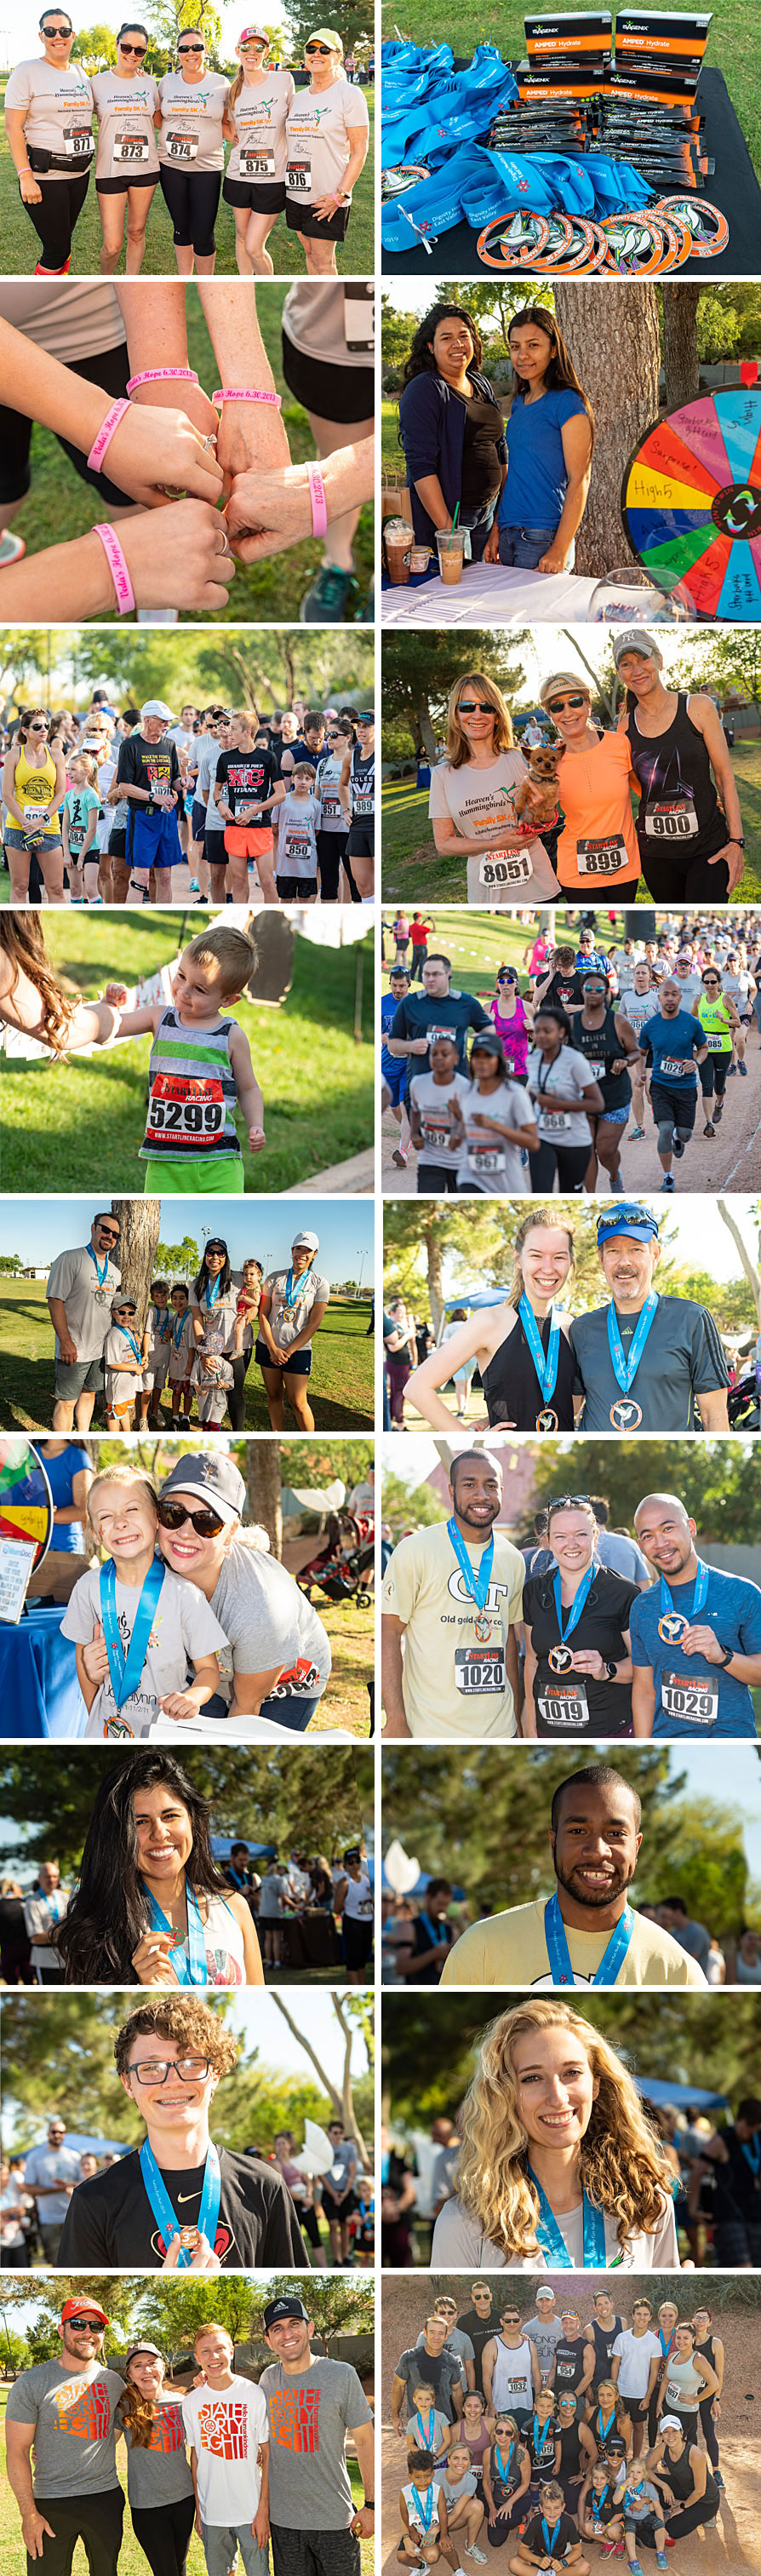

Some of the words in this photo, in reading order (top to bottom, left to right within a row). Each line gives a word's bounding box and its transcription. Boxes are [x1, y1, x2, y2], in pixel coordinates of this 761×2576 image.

[635, 93, 658, 101] Hydrate
[73, 138, 90, 152] 877
[121, 145, 143, 157] 873
[171, 143, 191, 156] 874
[246, 160, 268, 172] 875
[289, 173, 306, 186] 876
[432, 210, 450, 221] Dignity
[469, 209, 487, 218] Dignity
[488, 203, 502, 212] Health
[482, 210, 497, 220] Valley
[434, 218, 445, 227] East
[446, 210, 460, 222] Valley
[650, 228, 661, 244] FAMILY
[667, 228, 676, 245] FAMILY
[143, 371, 162, 380] Hope
[226, 389, 244, 398] Hope
[245, 390, 276, 402] 6.30.2013
[93, 432, 109, 456] Veda's
[106, 413, 119, 431] Hope
[312, 468, 324, 504] 6.30.2013
[112, 545, 124, 568] Hope
[120, 571, 134, 599] Veda's
[689, 572, 716, 603] High
[356, 801, 373, 811] 989
[465, 794, 494, 806] Heaven's
[323, 804, 336, 815] 851
[459, 800, 506, 817] Hummingbirds
[473, 816, 496, 827] Family
[653, 815, 690, 834] 900
[289, 845, 308, 856] 850
[585, 850, 622, 872] 899
[483, 858, 529, 883] 8051
[581, 1033, 607, 1043] BELIEVE
[663, 1062, 683, 1073] 1029
[150, 1098, 222, 1132] 5299
[543, 1117, 565, 1127] 968
[154, 1132, 214, 1142] WWW.STARTLINERACING.COM
[476, 1156, 498, 1168] 967
[440, 1616, 456, 1624] Old
[460, 1665, 503, 1686] 1020
[665, 1689, 714, 1717] 1029
[542, 1700, 583, 1720] 1019
[182, 2231, 196, 2243] 3rd
[560, 2367, 572, 2375] 954
[271, 2388, 315, 2407] STATE
[200, 2402, 242, 2418] STATE
[200, 2418, 242, 2435] FORTY
